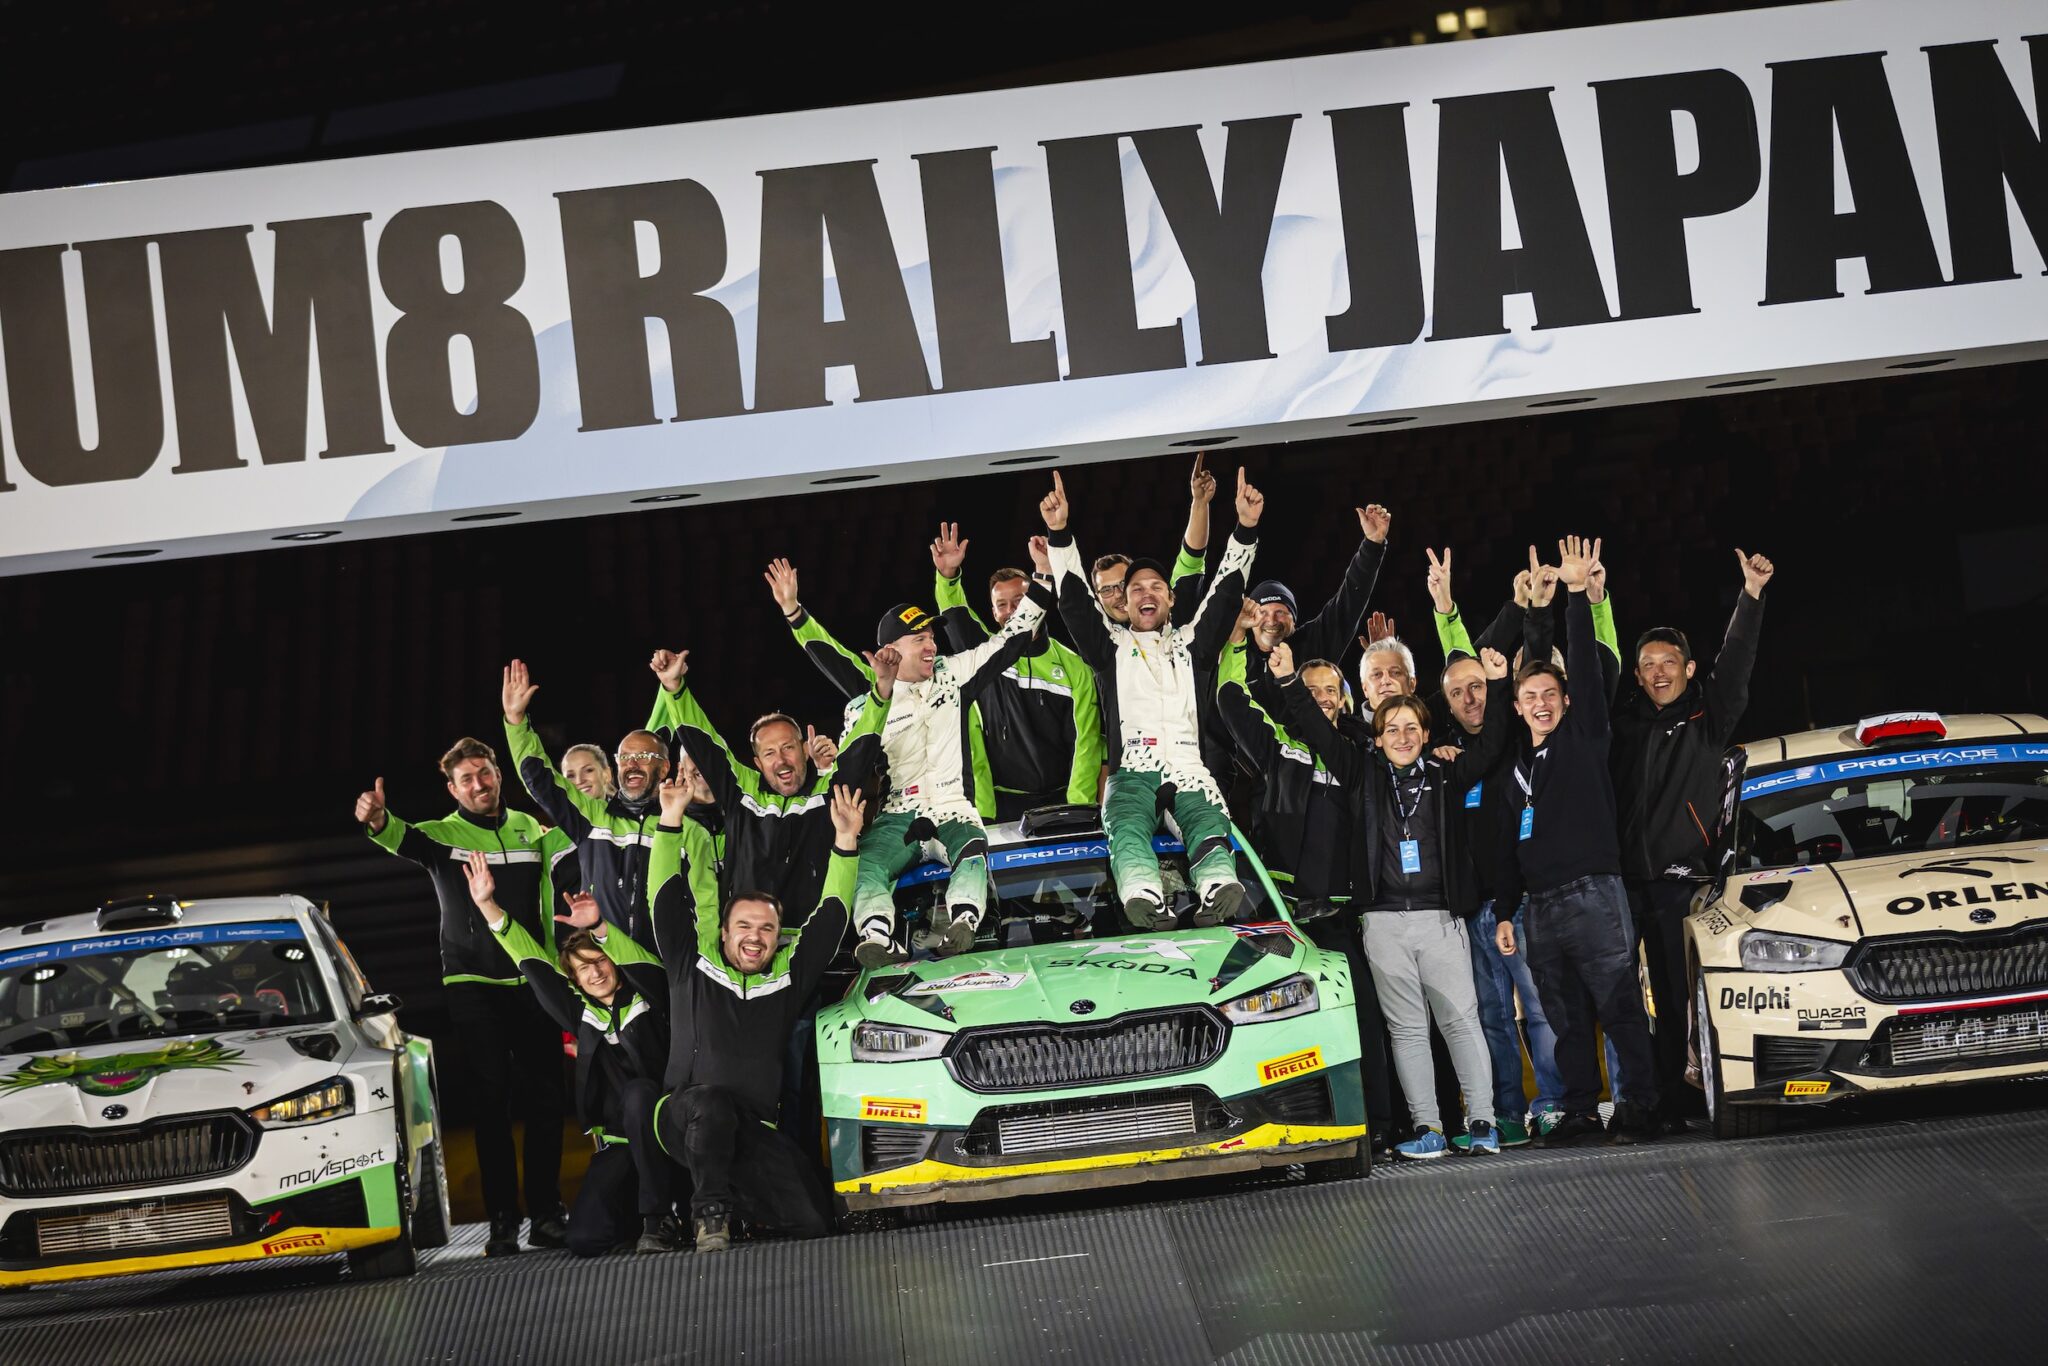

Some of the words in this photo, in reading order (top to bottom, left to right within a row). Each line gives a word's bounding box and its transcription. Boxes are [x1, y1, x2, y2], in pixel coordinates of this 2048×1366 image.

[0, 200, 541, 492] UM8
[551, 114, 1302, 433] RALLY
[1322, 33, 2048, 354] JAPAN
[1886, 882, 2048, 915] ORLEN
[1720, 986, 1790, 1014] Delphi
[1797, 1007, 1866, 1021] QUAZAR
[1263, 1051, 1318, 1081] PIRELLI
[1788, 1083, 1827, 1093] PIRELLI
[866, 1101, 922, 1119] PIRELLI
[280, 1148, 385, 1190] movisport
[262, 1233, 326, 1256] PIRELLI
